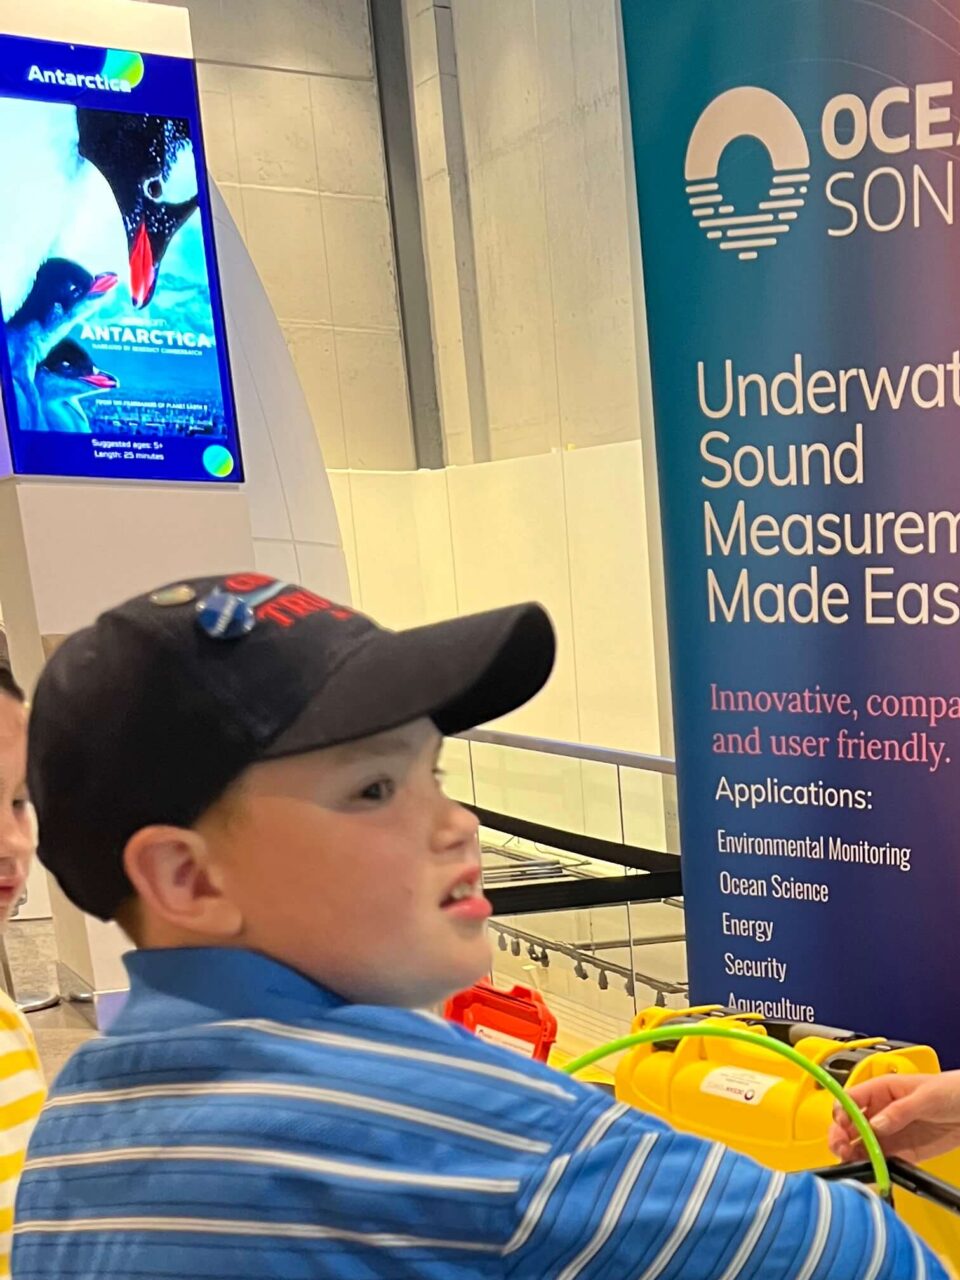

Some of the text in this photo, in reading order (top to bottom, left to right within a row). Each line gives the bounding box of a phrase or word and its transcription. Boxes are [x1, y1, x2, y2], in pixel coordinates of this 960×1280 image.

[27, 65, 132, 93] Antarctica
[80, 325, 212, 348] ANTARCTICA
[91, 438, 131, 449] Suggested
[135, 452, 165, 461] minutes
[700, 423, 863, 489] Sound
[707, 566, 850, 625] Made
[710, 683, 858, 721] Innovative,
[712, 727, 951, 772] and user friendly.
[715, 776, 874, 810] Applications:
[717, 829, 912, 871] Environmental Monitoring
[719, 871, 829, 902] Ocean Science
[722, 912, 774, 942] Energy
[724, 952, 787, 982] Security
